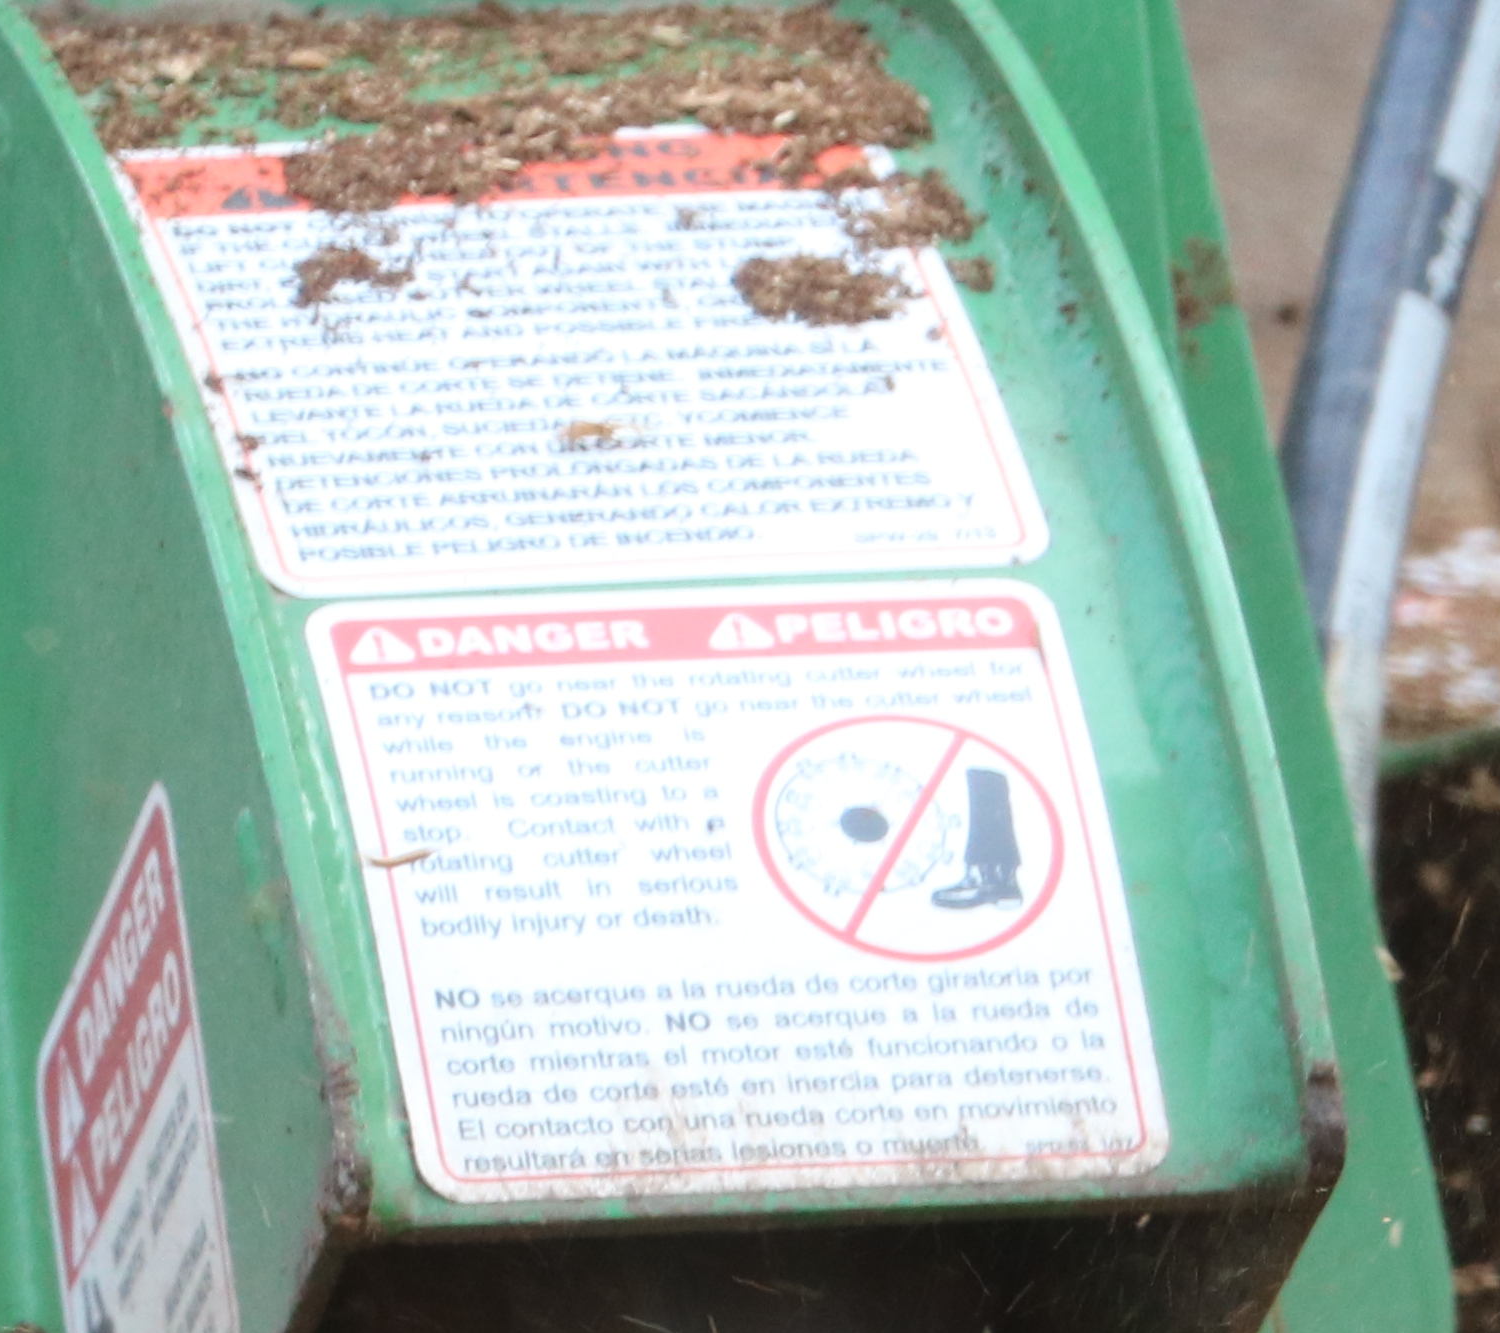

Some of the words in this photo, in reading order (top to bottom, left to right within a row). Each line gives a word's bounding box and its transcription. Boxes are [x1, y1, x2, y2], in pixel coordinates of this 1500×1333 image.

[461, 323, 524, 339] AND
[622, 349, 659, 363] LA
[841, 337, 878, 353] LA
[243, 385, 346, 403] RUEDA
[351, 383, 388, 397] DE
[398, 378, 497, 394] CORTE
[507, 376, 541, 389] SE
[697, 358, 947, 381] INMEDIATAMENTE
[251, 405, 380, 424] LEVANTE
[390, 402, 430, 416] LA
[434, 396, 537, 416] RUEDA
[542, 393, 580, 409] DE
[590, 389, 688, 406] CORTE
[258, 430, 309, 446] DEL
[473, 442, 539, 457] CON
[273, 468, 483, 494] DETENCIONES
[489, 456, 718, 480] PROLONGADAS
[725, 454, 762, 469] DE
[772, 452, 809, 467] LA
[816, 449, 917, 465] RUEDA
[278, 498, 321, 515] DE
[329, 492, 429, 512] CORTE
[639, 480, 699, 497] LOS
[706, 471, 931, 493] COMPONENTES
[504, 504, 693, 527] GENERANDO
[699, 499, 801, 517] CALOR
[808, 494, 951, 513] EXTREMO
[297, 542, 421, 563] POSIBLE
[430, 534, 561, 555] PELIGRO
[568, 532, 606, 548] DE
[418, 620, 649, 657] DANGER
[774, 607, 1013, 643] PELIGRO
[368, 681, 415, 701] DO
[429, 678, 490, 697] NOT
[508, 680, 542, 698] go
[556, 678, 615, 691] near
[631, 673, 674, 688] the
[688, 670, 791, 687] rotating
[805, 666, 879, 681] cutter
[898, 662, 975, 678] wheel
[989, 660, 1021, 675] for
[377, 713, 424, 729] any
[560, 700, 607, 720] DO
[617, 697, 678, 717] NOT
[694, 701, 728, 718] go
[739, 698, 797, 711] near
[810, 693, 853, 708] the
[865, 691, 938, 707] cutter
[954, 686, 1032, 704] wheel
[383, 736, 453, 755] while
[483, 734, 527, 749] the
[559, 731, 652, 749] engine
[684, 729, 704, 741] is
[389, 765, 494, 783] running
[517, 764, 541, 777] or
[567, 759, 610, 775] the
[635, 755, 708, 772] cutter
[395, 792, 477, 812] wheel
[493, 793, 514, 807] is
[530, 787, 646, 807] coasting
[661, 785, 687, 800] to
[703, 787, 718, 799] a
[507, 816, 614, 837] Contact
[634, 813, 689, 832] with
[407, 854, 513, 874] rotating
[543, 848, 618, 867] cutter
[650, 841, 732, 862] wheel
[414, 883, 458, 905] will
[484, 879, 560, 902] result
[587, 879, 611, 897] in
[637, 874, 738, 895] serious
[419, 914, 501, 940] bodily
[511, 912, 586, 938] injury
[595, 913, 622, 929] or
[76, 847, 165, 1086] DANGER
[433, 987, 480, 1010] NO
[490, 991, 523, 1008] se
[532, 985, 646, 1008] acerque
[656, 984, 673, 1001] a
[681, 978, 706, 1000] la
[715, 974, 795, 998] rueda
[805, 972, 839, 995] de
[848, 971, 917, 993] corte
[927, 967, 1040, 996] giratoria
[1048, 968, 1091, 991] por
[440, 1018, 534, 1047] ningún
[664, 1010, 711, 1033] NO
[725, 1014, 759, 1030] se
[774, 1009, 886, 1030] acerque
[902, 1007, 918, 1024] a
[932, 1001, 957, 1023] la
[971, 997, 1050, 1021] rueda
[1064, 996, 1099, 1018] de
[445, 1053, 515, 1076] corte
[529, 1048, 650, 1072] mientras
[663, 1044, 687, 1066] el
[701, 1042, 780, 1065] motor
[794, 1037, 853, 1061] esté
[866, 1031, 1038, 1058] funcionando
[1050, 1035, 1068, 1052] o
[1080, 1028, 1105, 1050] la
[90, 949, 182, 1194] PELIGRO
[451, 1084, 532, 1109] rueda
[542, 1082, 578, 1104] de
[589, 1079, 660, 1103] corte
[669, 1074, 729, 1103] esté
[740, 1078, 775, 1096] en
[786, 1070, 879, 1094] inercia
[890, 1071, 953, 1093] para
[457, 1118, 485, 1141] El
[494, 1115, 614, 1140] contacto
[622, 1112, 677, 1135] con
[681, 1112, 736, 1133] una
[740, 1104, 825, 1129] rueda
[834, 1102, 904, 1125] corte
[913, 1104, 948, 1121] en
[957, 1094, 1117, 1122] movimiento
[463, 1148, 586, 1175] resultará
[594, 1147, 635, 1170] en
[730, 1139, 847, 1164] lesiones
[855, 1139, 873, 1157] o
